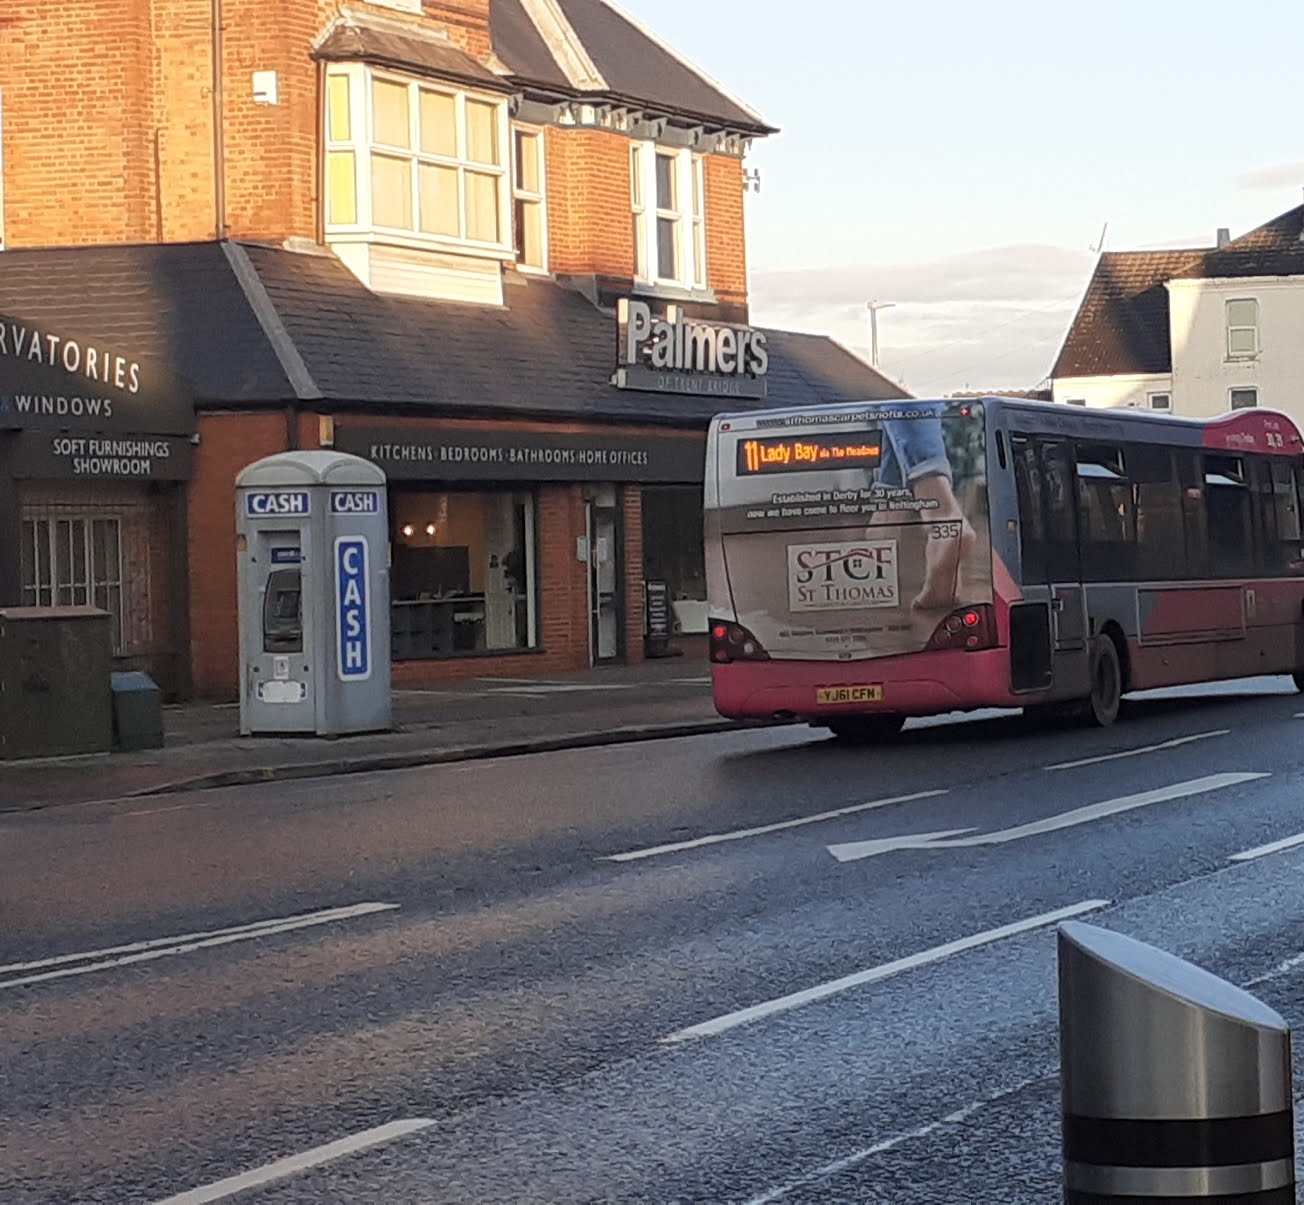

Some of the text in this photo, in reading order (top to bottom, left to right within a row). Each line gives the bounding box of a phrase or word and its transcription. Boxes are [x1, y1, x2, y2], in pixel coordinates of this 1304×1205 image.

[624, 300, 768, 376] Palmers
[15, 395, 112, 417] WINDOWS
[53, 438, 169, 458] SOFT FURNISHINGS
[371, 444, 648, 465] KITCHENS BEDROOMS BATHROOMS HOME OFFICES
[744, 440, 759, 472] 11
[760, 443, 790, 464] Lady
[795, 442, 819, 462] Bay
[73, 457, 151, 475] SHOWROOM
[252, 494, 302, 513] CASH
[334, 493, 373, 511] CASH
[773, 492, 821, 504] Established
[823, 492, 831, 501] in
[834, 489, 858, 502] Derby
[860, 488, 872, 499] for
[874, 488, 884, 498] 30
[747, 509, 764, 519] now
[767, 509, 779, 518] we
[782, 506, 801, 517] have
[804, 506, 827, 516] come
[829, 505, 837, 515] to
[861, 503, 877, 515] you
[879, 502, 887, 512] in
[889, 499, 938, 513] Nottingham
[932, 524, 959, 539] 335
[797, 547, 892, 584] STCF
[821, 584, 894, 601] THOMAS
[343, 547, 362, 668] CASH
[824, 687, 875, 702] YJ61 CFN
